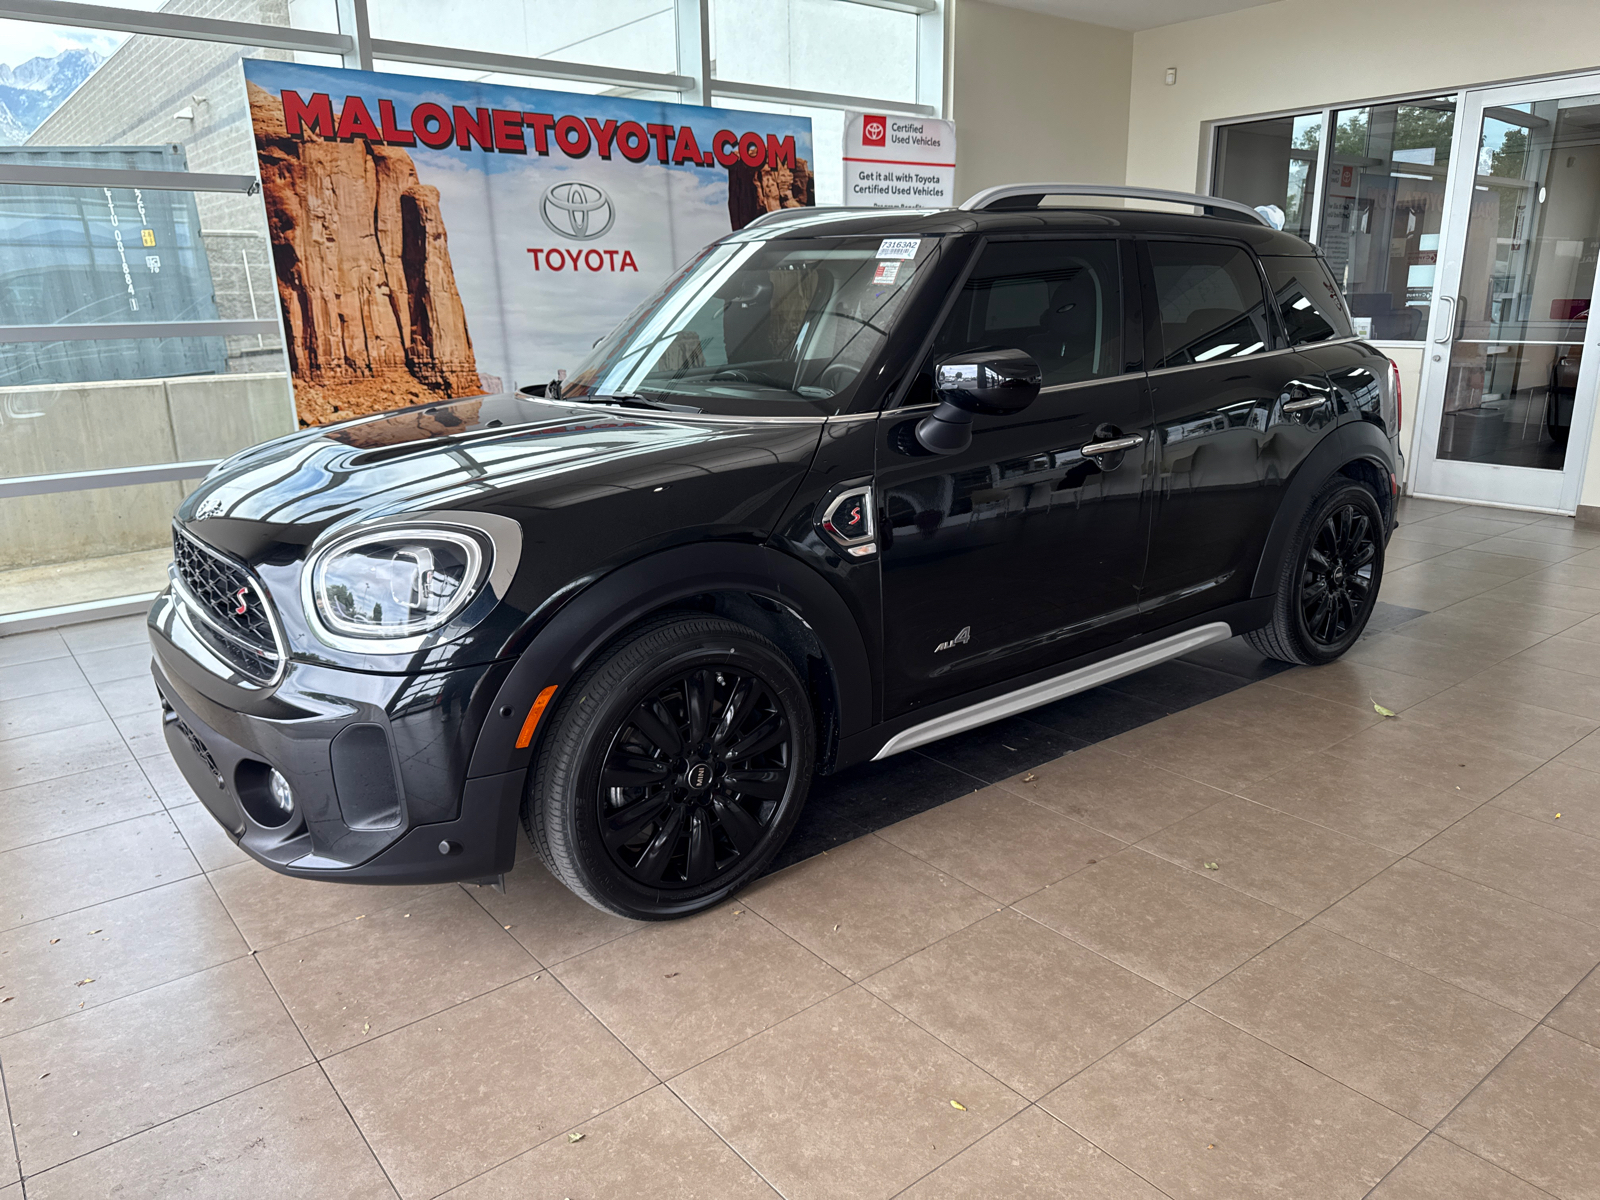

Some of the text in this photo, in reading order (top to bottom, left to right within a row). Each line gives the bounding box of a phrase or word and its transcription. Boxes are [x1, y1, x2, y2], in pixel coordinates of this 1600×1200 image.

[281, 89, 796, 171] MALONETOYOTA.COM
[891, 122, 924, 134] Certified
[891, 134, 941, 147] Used Vehicles
[858, 171, 940, 185] Get it all with Toyota
[853, 184, 944, 197] Certified Used Vehicles
[526, 248, 639, 273] TOYOTA
[848, 507, 860, 526] S
[235, 587, 248, 615] S
[933, 625, 971, 654] ALL4
[695, 767, 705, 787] MINI
